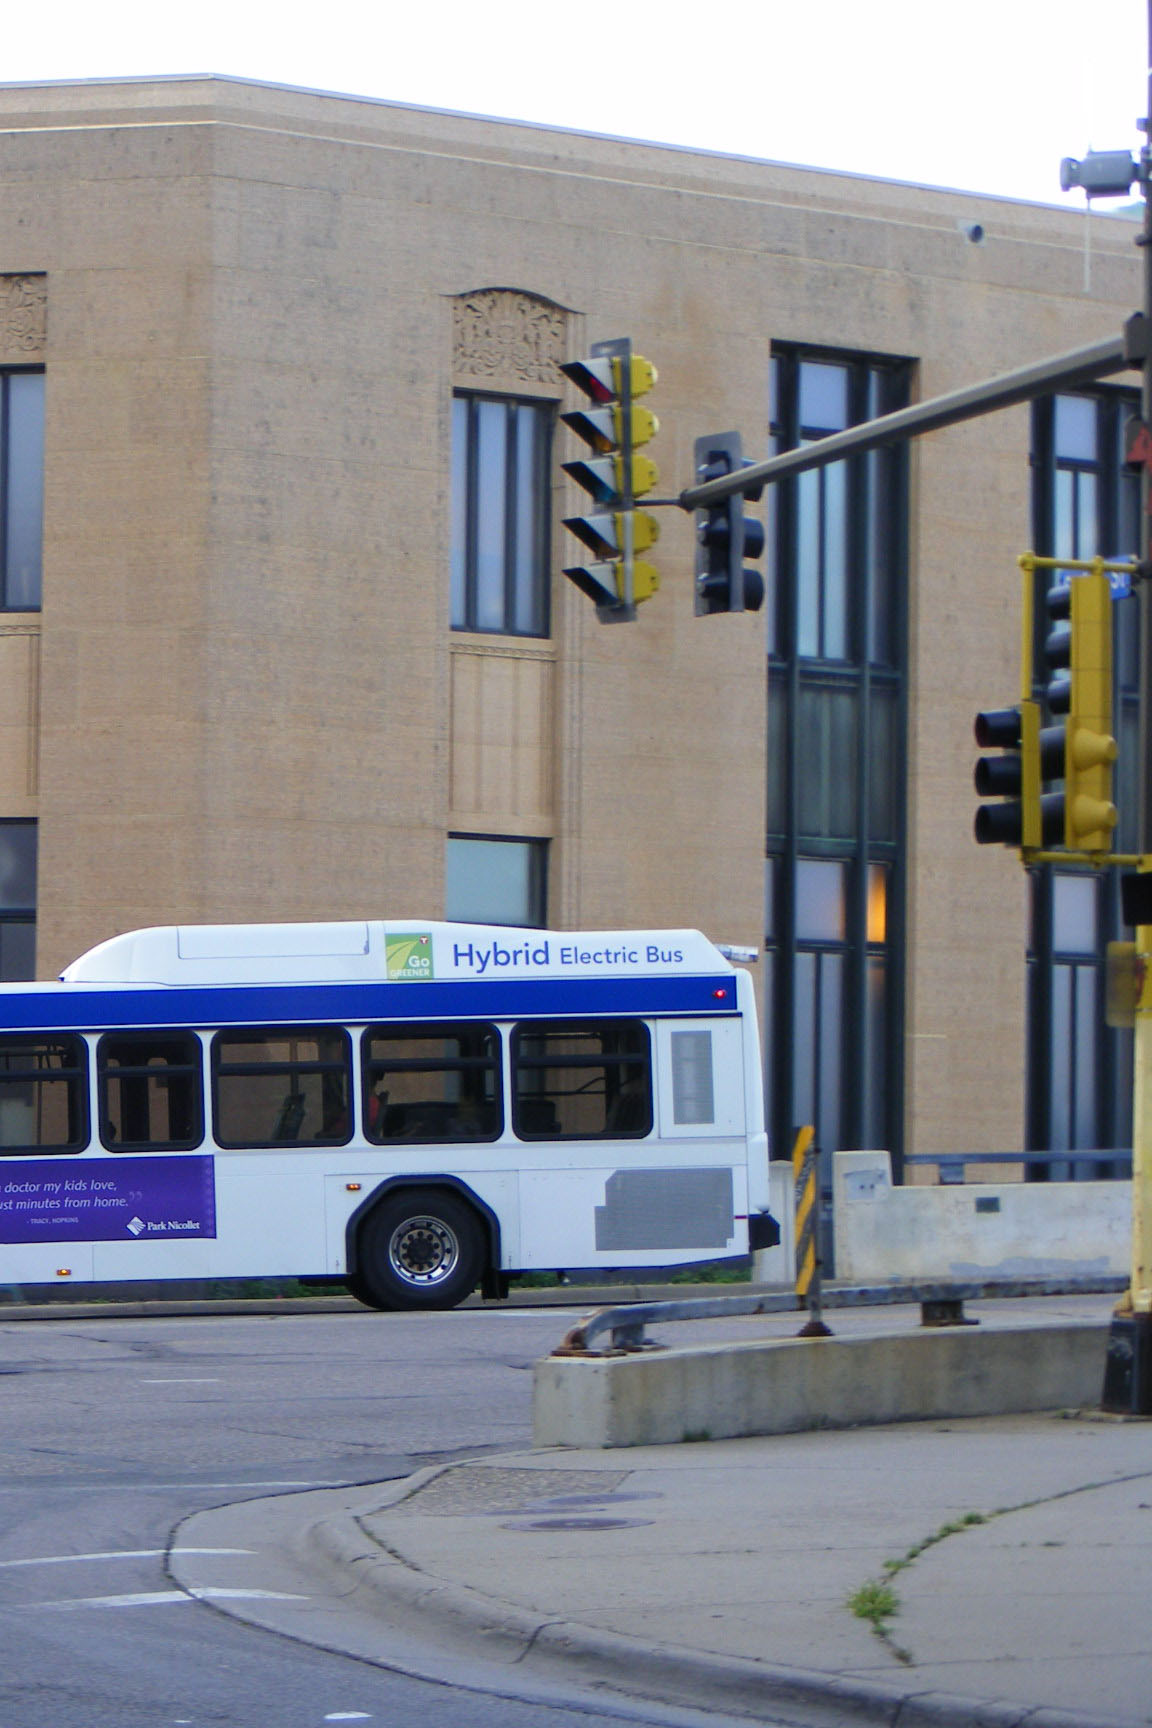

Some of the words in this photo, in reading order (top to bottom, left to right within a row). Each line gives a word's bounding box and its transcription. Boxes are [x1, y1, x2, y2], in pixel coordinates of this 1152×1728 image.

[408, 955, 430, 968] Go
[453, 940, 550, 973] Hybrid
[559, 946, 638, 965] Electric
[646, 945, 684, 963] Bus
[390, 968, 430, 977] GREENER
[4, 1181, 41, 1193] doctor
[43, 1183, 61, 1194] my
[64, 1180, 87, 1191] kids
[90, 1179, 117, 1191] love,
[16, 1198, 61, 1209] minutes
[64, 1197, 91, 1208] from
[147, 1221, 166, 1231] Park
[168, 1220, 200, 1230] Nicollet
